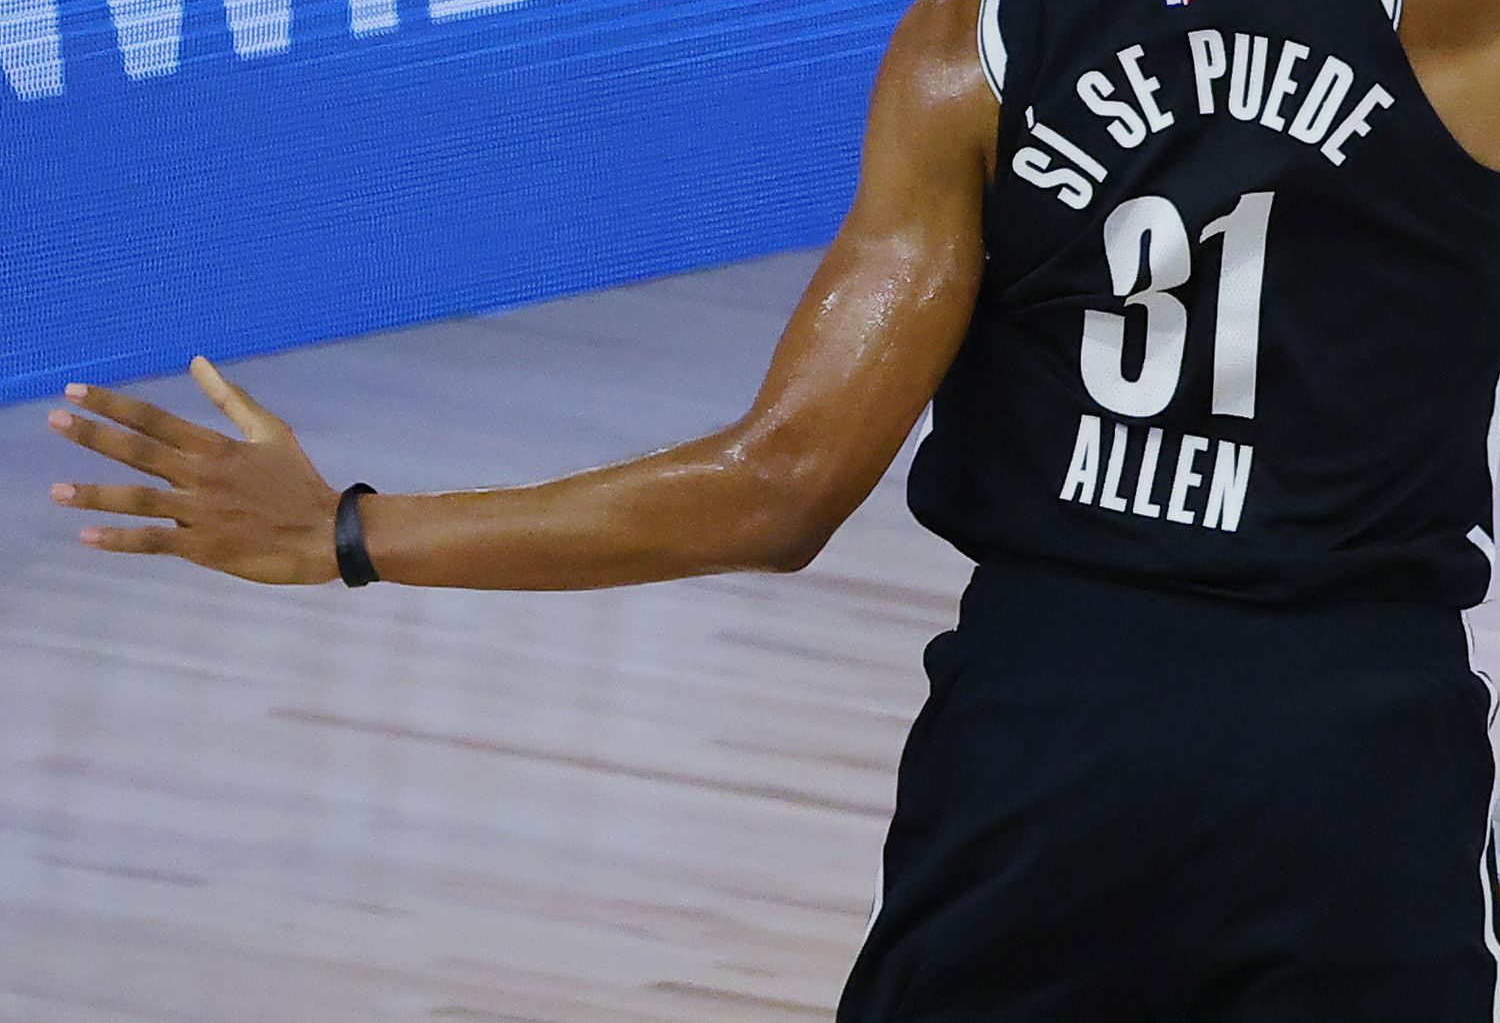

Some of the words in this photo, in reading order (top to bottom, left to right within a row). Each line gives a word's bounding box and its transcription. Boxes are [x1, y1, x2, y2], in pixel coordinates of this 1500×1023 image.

[1011, 105, 1108, 210] SÍ
[1076, 44, 1175, 148] SE
[1188, 29, 1395, 167] PUEDE
[1080, 190, 1275, 419] 31
[1059, 414, 1254, 533] ALLEN
